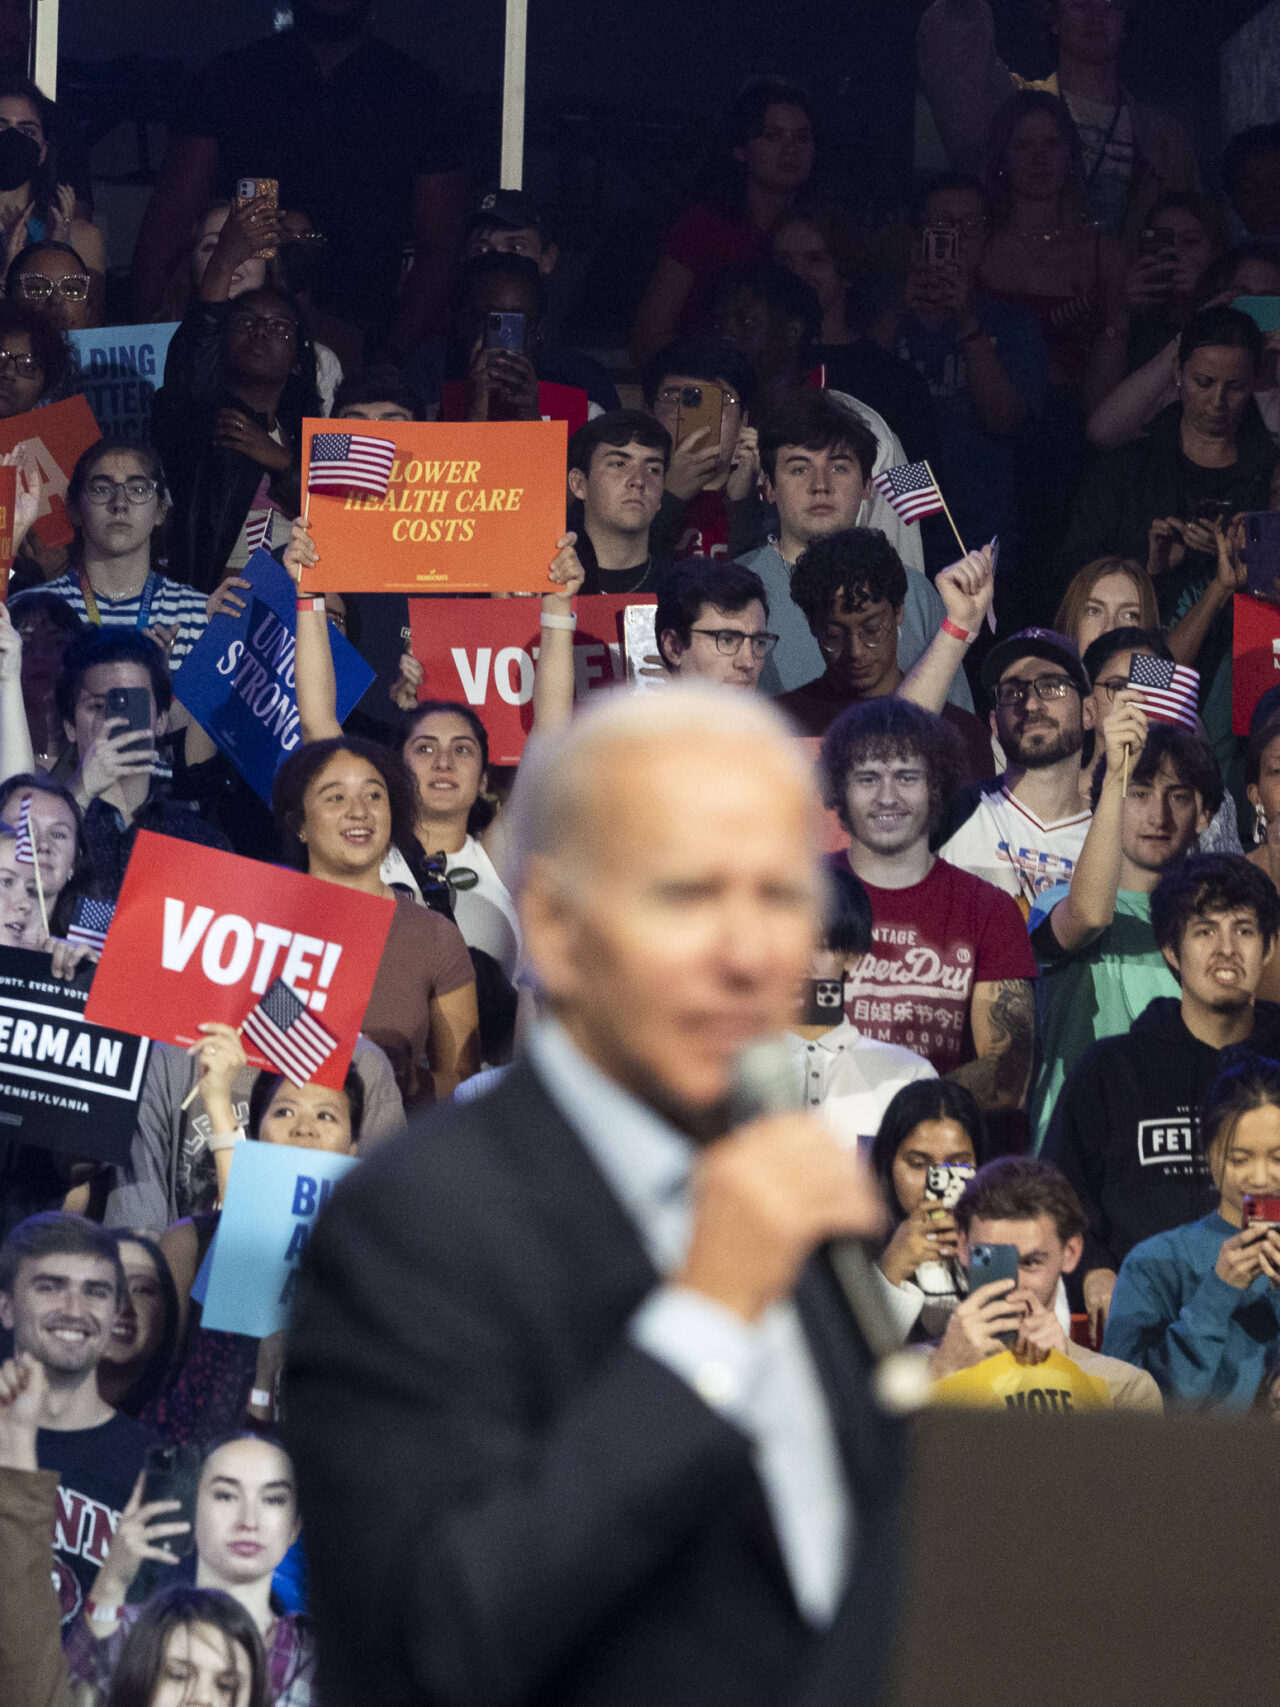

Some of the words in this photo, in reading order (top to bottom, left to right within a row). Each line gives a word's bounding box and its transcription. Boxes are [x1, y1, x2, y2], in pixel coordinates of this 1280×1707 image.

[389, 460, 482, 484] LOWER
[344, 488, 449, 513] HEALTH
[455, 488, 524, 513] CARE
[392, 518, 476, 543] COSTS
[216, 639, 301, 751] STRONG
[162, 896, 343, 1012] VOTE!
[28, 980, 61, 995] EVERY
